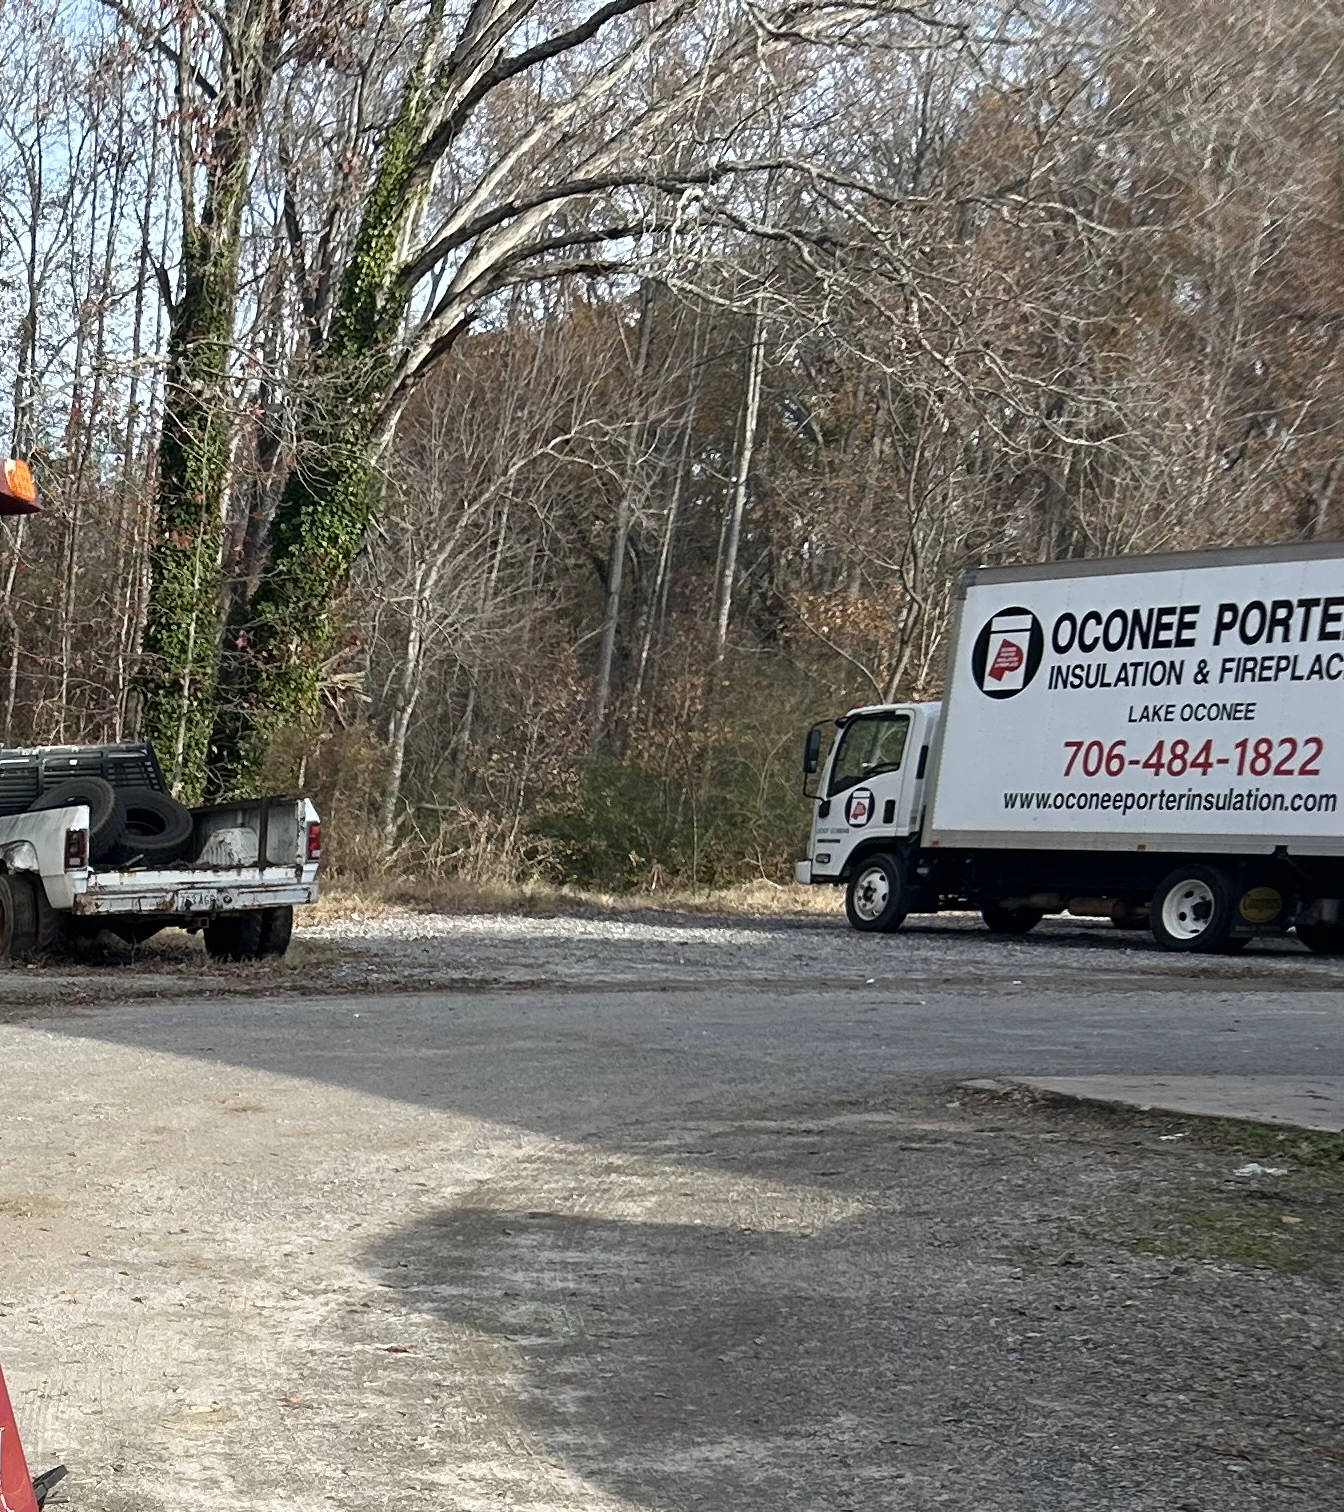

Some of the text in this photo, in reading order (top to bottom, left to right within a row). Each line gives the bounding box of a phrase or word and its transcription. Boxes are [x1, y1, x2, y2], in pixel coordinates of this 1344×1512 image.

[1052, 596, 1344, 655] OCONEE PORTE
[1048, 652, 1344, 690] INSULATION & FIREPLAC
[1128, 703, 1256, 723] LAKE OCONEE
[1063, 737, 1324, 777] 706-484-1822
[1003, 789, 1338, 816] www.oconeeporterinsulation.com
